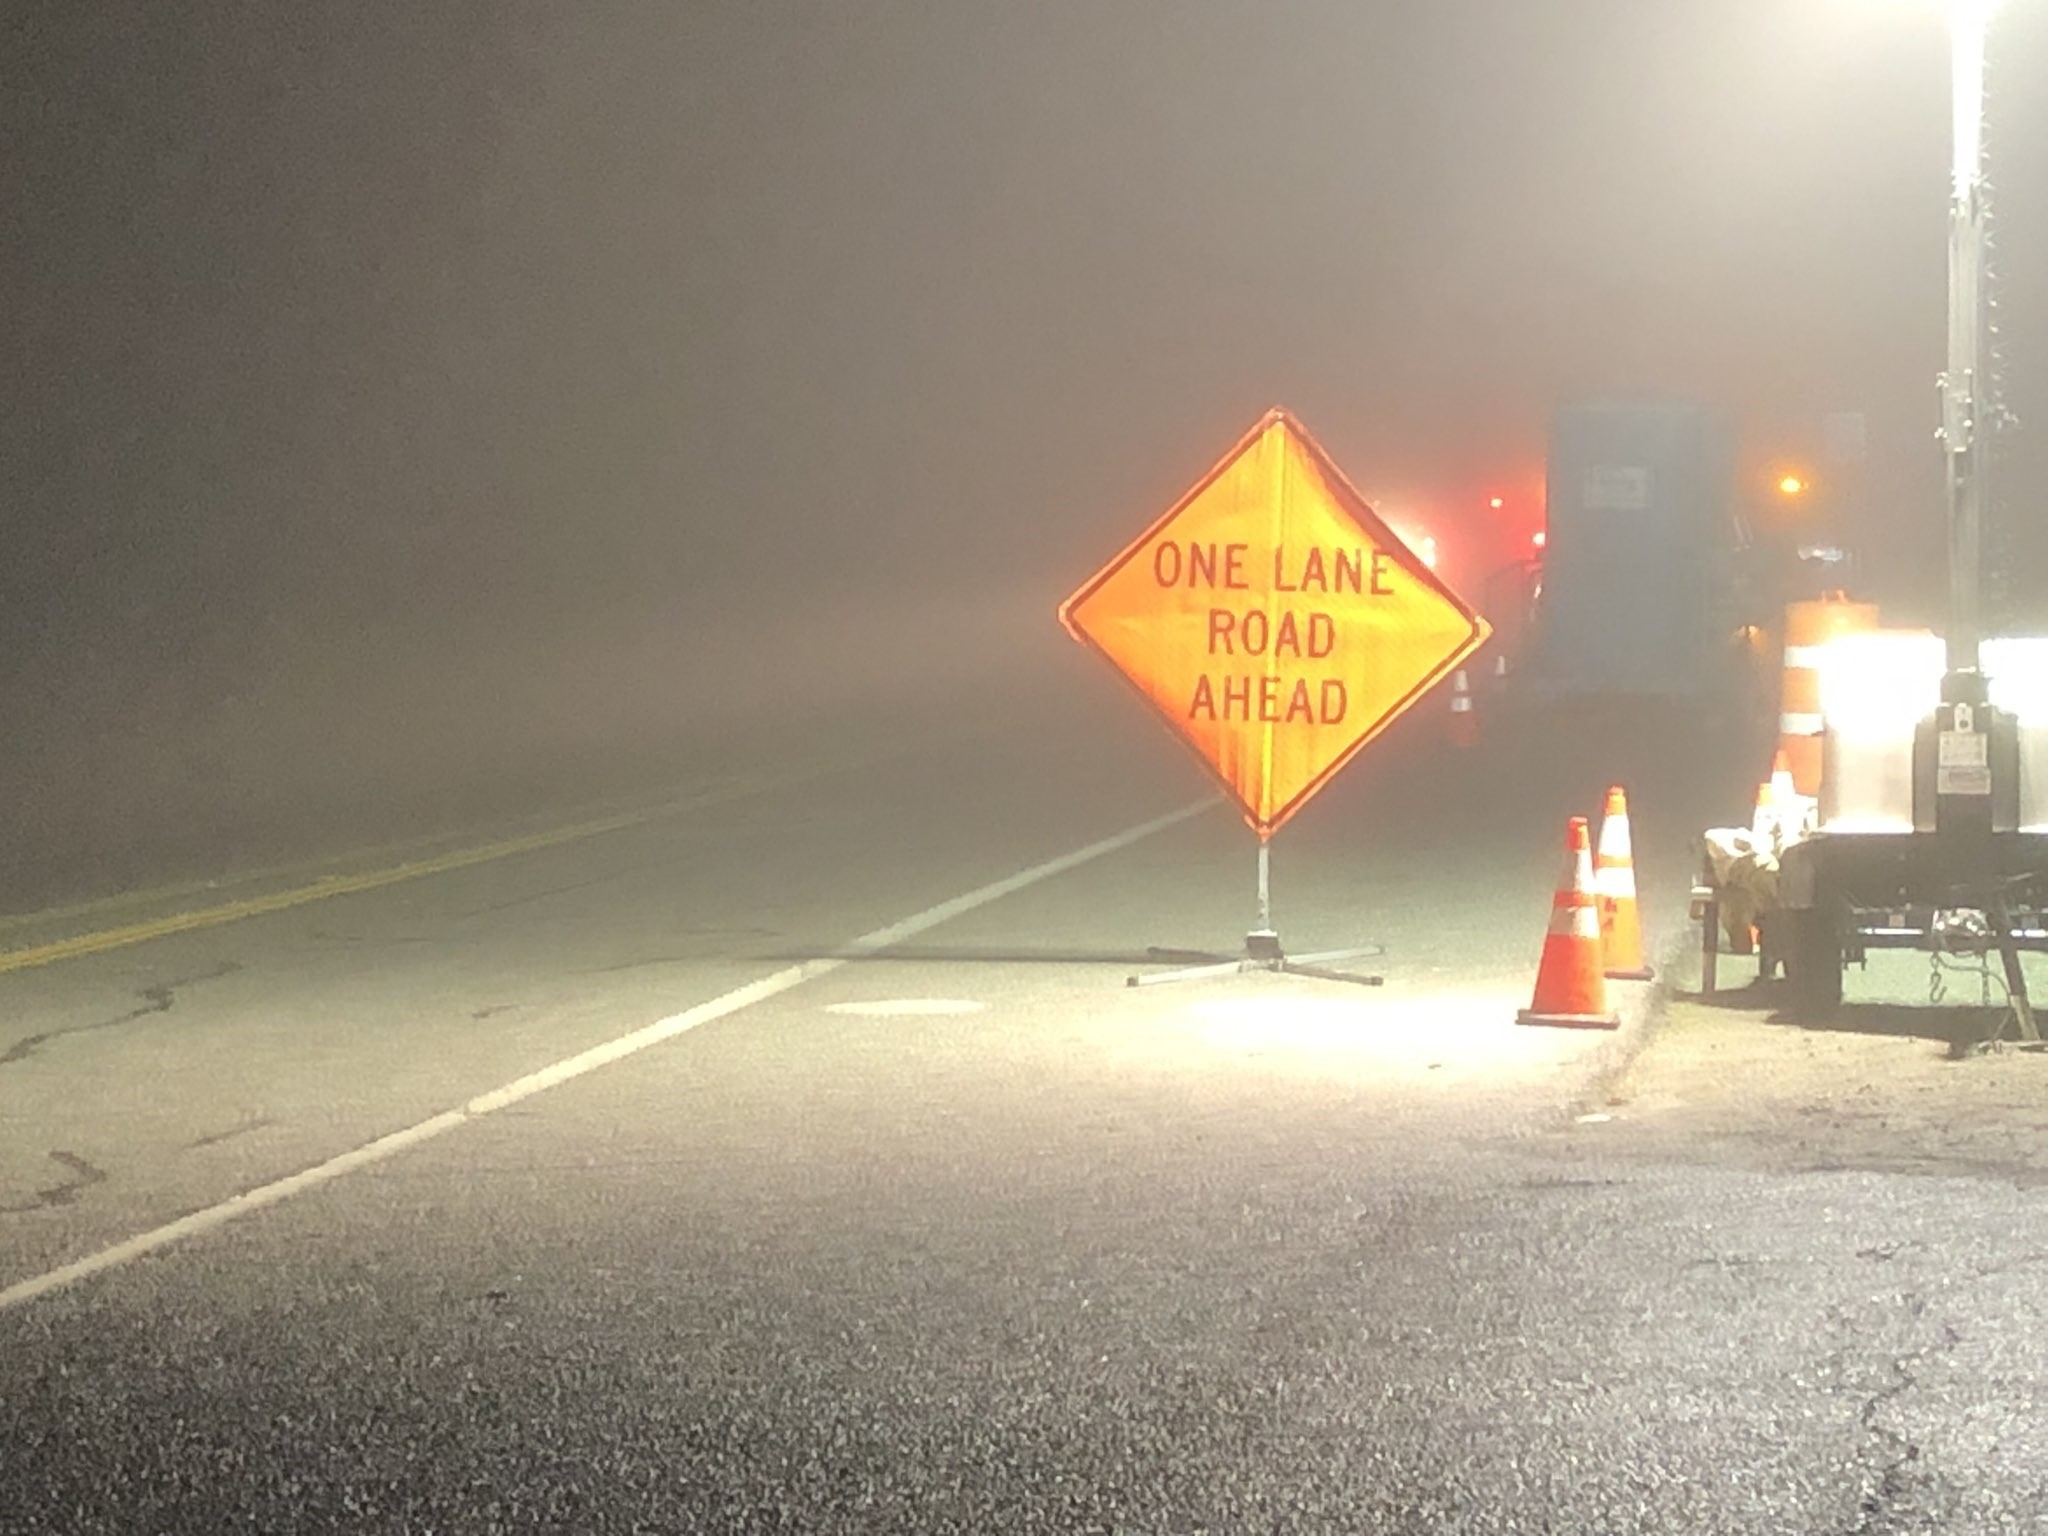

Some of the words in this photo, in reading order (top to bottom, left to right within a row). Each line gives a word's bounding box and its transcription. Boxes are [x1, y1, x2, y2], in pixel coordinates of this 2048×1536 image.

[1154, 541, 1249, 590] ONE
[1274, 545, 1394, 595] LANE
[1209, 609, 1336, 658] ROAD
[1189, 675, 1348, 725] AHEAD
